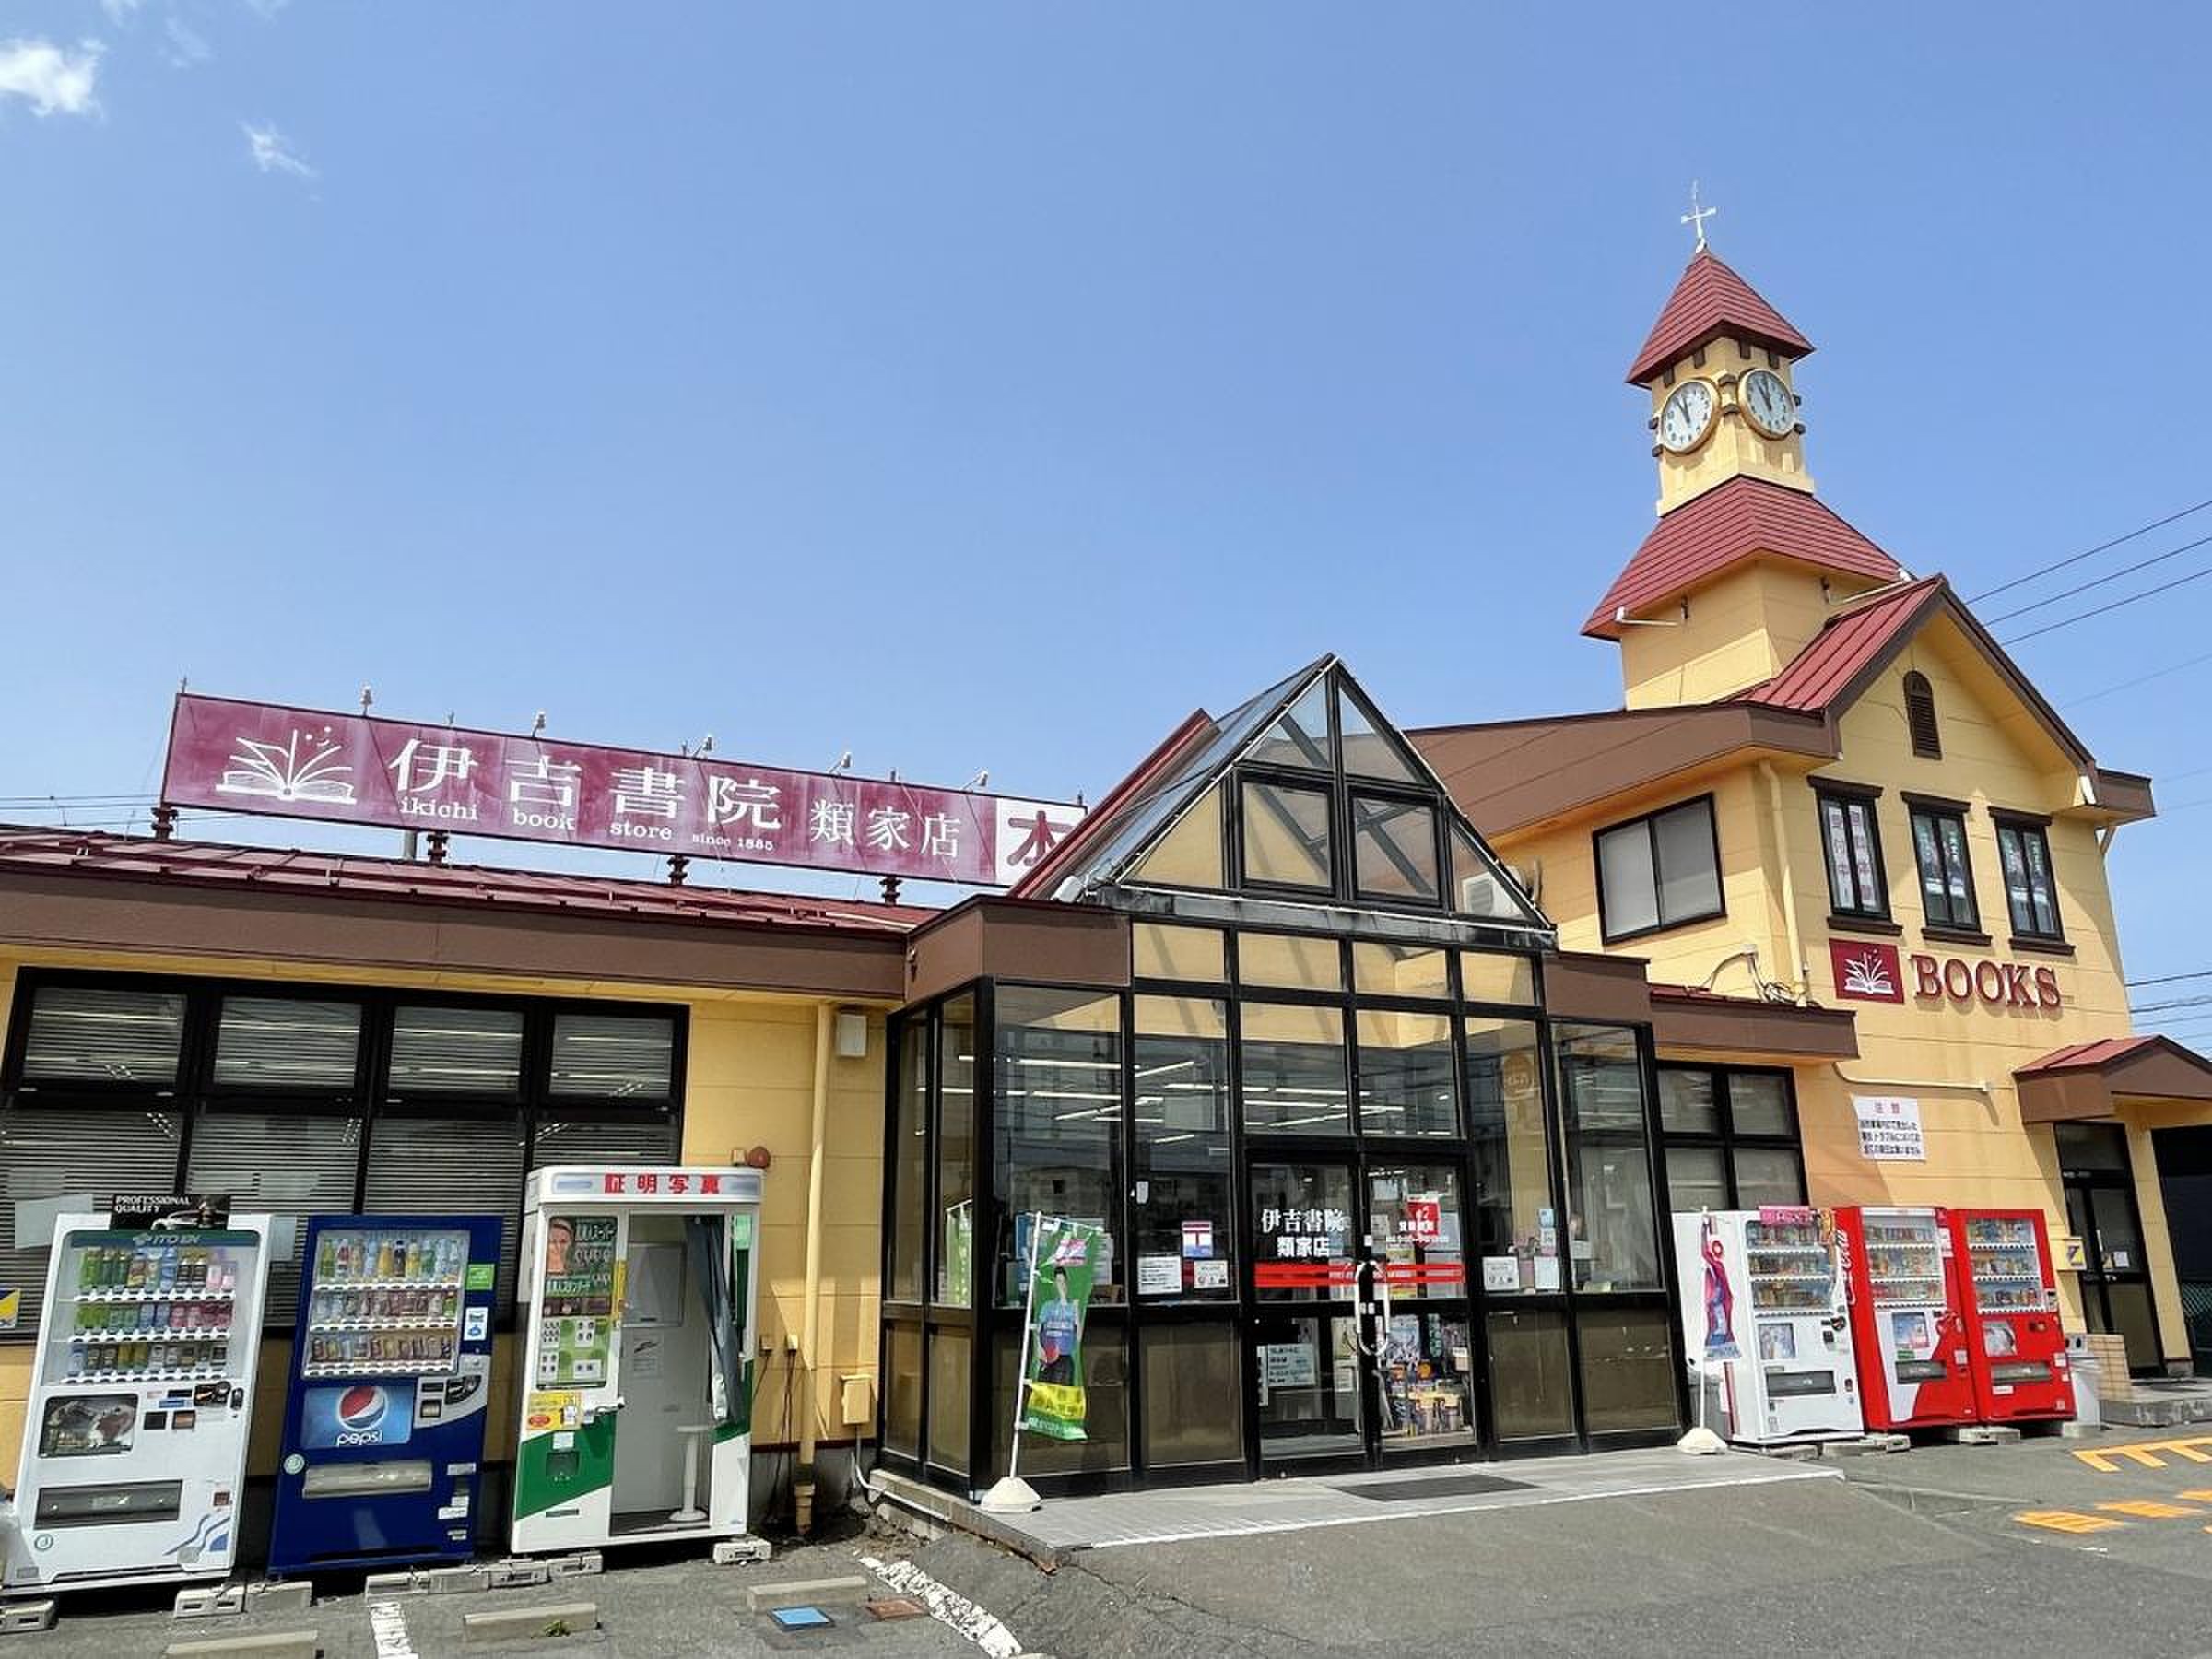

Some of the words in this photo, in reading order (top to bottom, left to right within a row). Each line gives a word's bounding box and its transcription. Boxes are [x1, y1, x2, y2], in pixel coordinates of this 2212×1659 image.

[389, 738, 782, 829] 伊吉書院
[810, 799, 959, 858] 類家店
[400, 794, 478, 821] ikichi
[512, 807, 576, 830] book
[609, 818, 674, 841] store
[692, 833, 731, 847] since
[1909, 954, 2062, 1007] BOOKS
[604, 1173, 722, 1194] 証明写真
[1261, 1208, 1347, 1235] 伊吉書院
[1277, 1235, 1330, 1258] 類家店
[336, 1430, 382, 1446] pepsi
